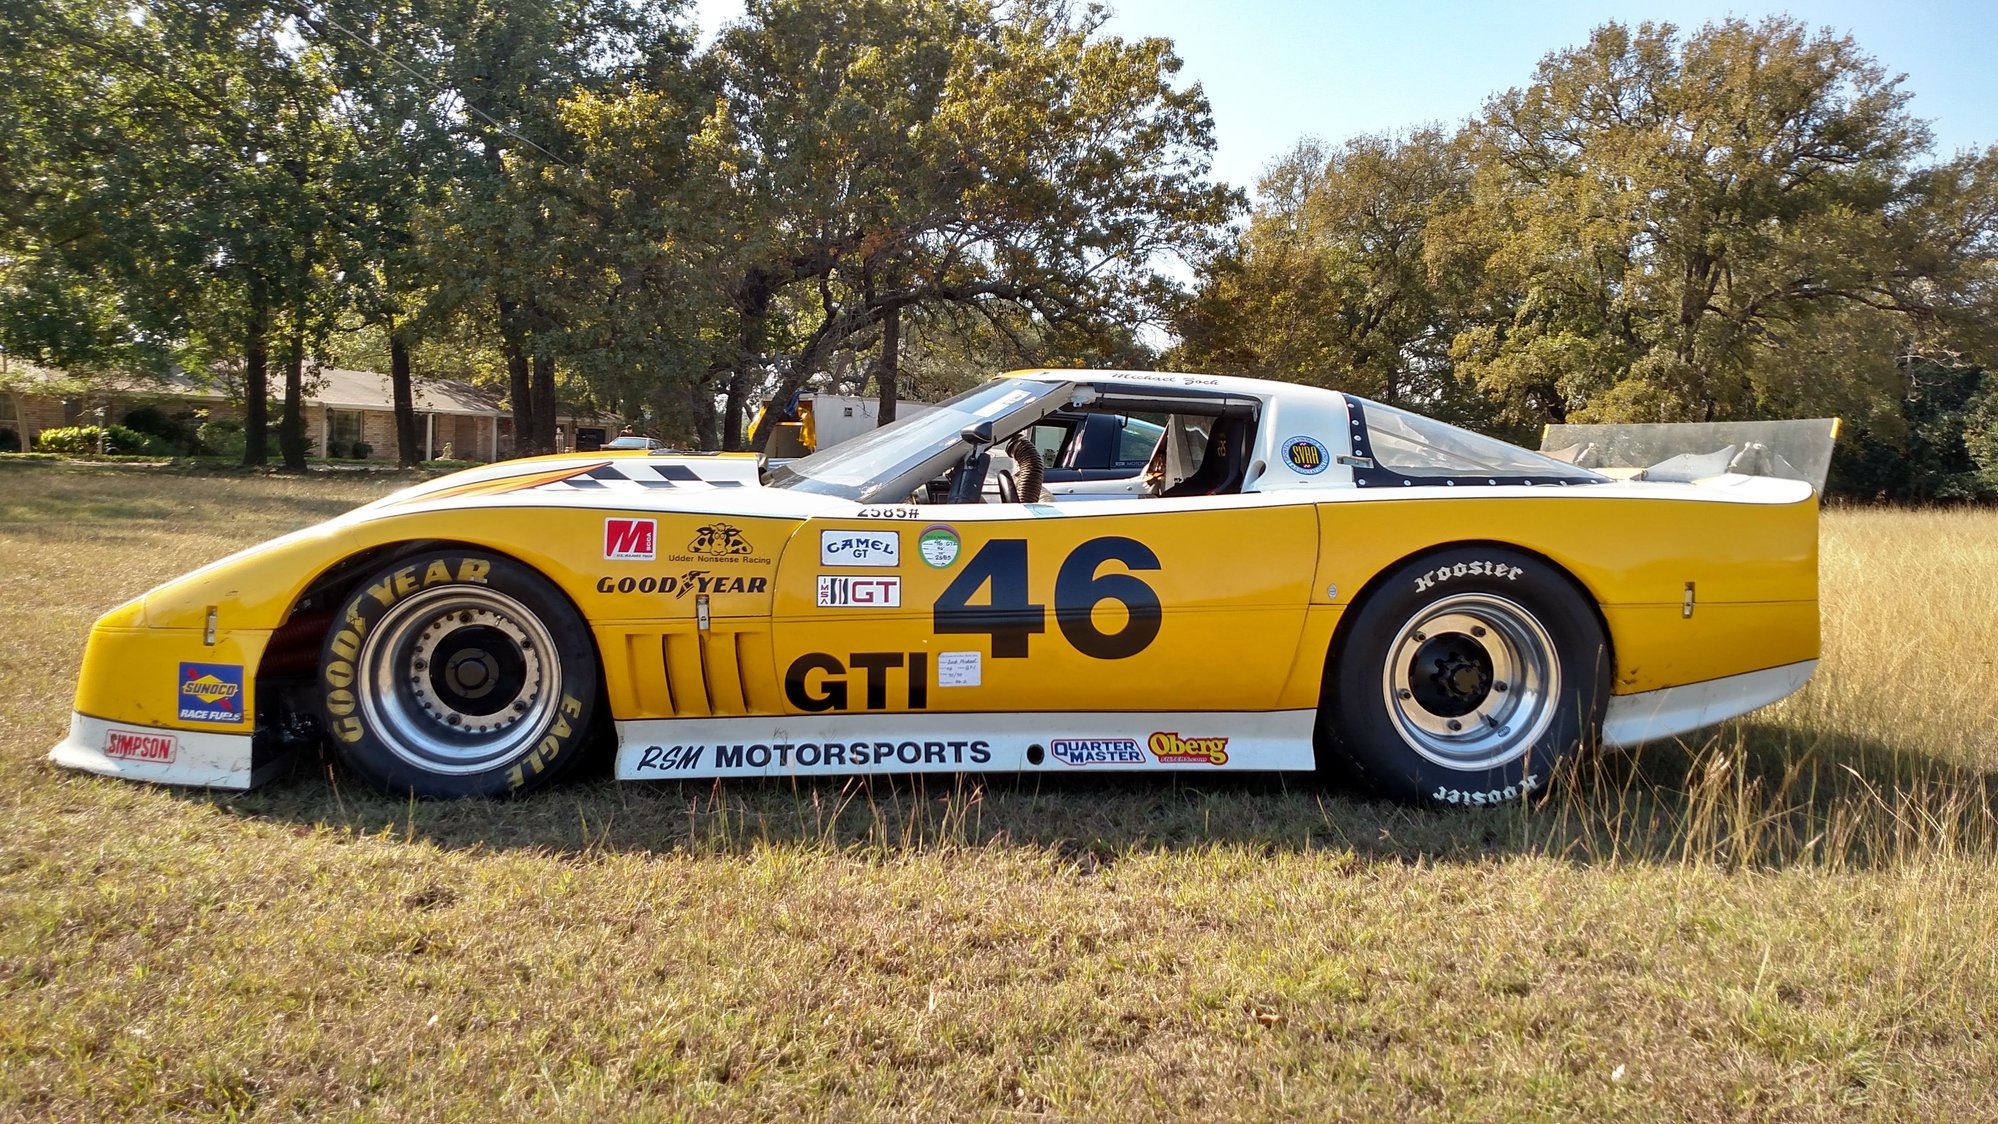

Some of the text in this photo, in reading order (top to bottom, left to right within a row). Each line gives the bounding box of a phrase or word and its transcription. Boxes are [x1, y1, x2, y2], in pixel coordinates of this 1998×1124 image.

[1292, 445, 1319, 464] SVRA
[827, 538, 894, 555] CAMEL
[853, 549, 868, 558] GT
[668, 555, 771, 565] Udder Nonsense Racing
[1413, 560, 1523, 593] Hoosier
[851, 581, 897, 603] GT
[933, 536, 1162, 660] 46
[184, 682, 236, 696] SUNOCO
[785, 652, 928, 712] GTI
[180, 709, 241, 722] RACE FUELS
[109, 732, 172, 760] SIMPSON
[505, 693, 582, 792] EAGLE
[1054, 741, 1136, 757] QUARTER
[1149, 732, 1227, 765] Oberg
[636, 740, 992, 771] RSM MOTORSPORTS
[1070, 751, 1141, 763] MASTER
